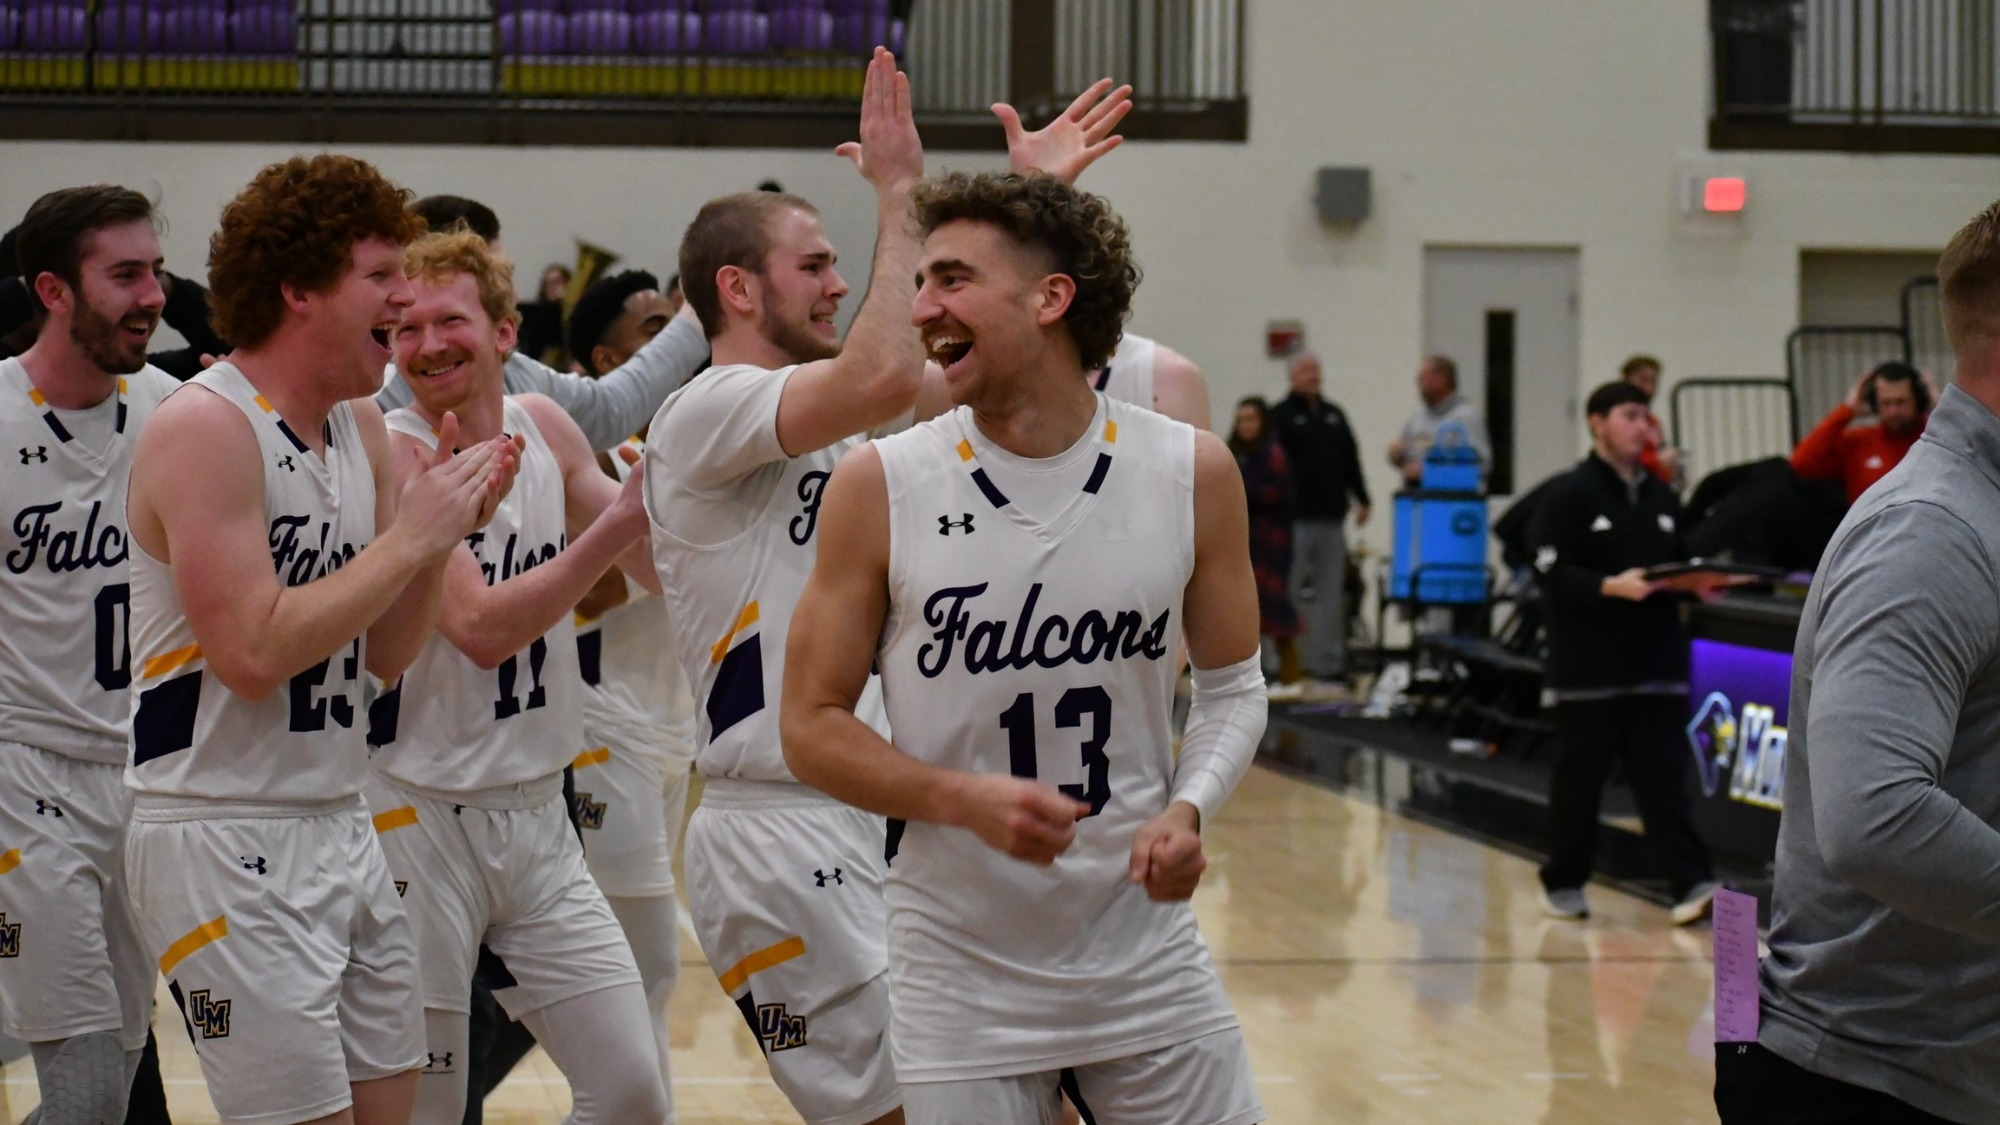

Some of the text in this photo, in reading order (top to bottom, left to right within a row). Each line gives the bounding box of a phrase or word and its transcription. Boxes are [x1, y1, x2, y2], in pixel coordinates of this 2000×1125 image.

[6, 500, 129, 574] Falc
[917, 582, 1170, 678] Falcons
[1000, 685, 1112, 822] 13
[190, 989, 231, 1039] UM
[757, 1003, 807, 1052] UM
